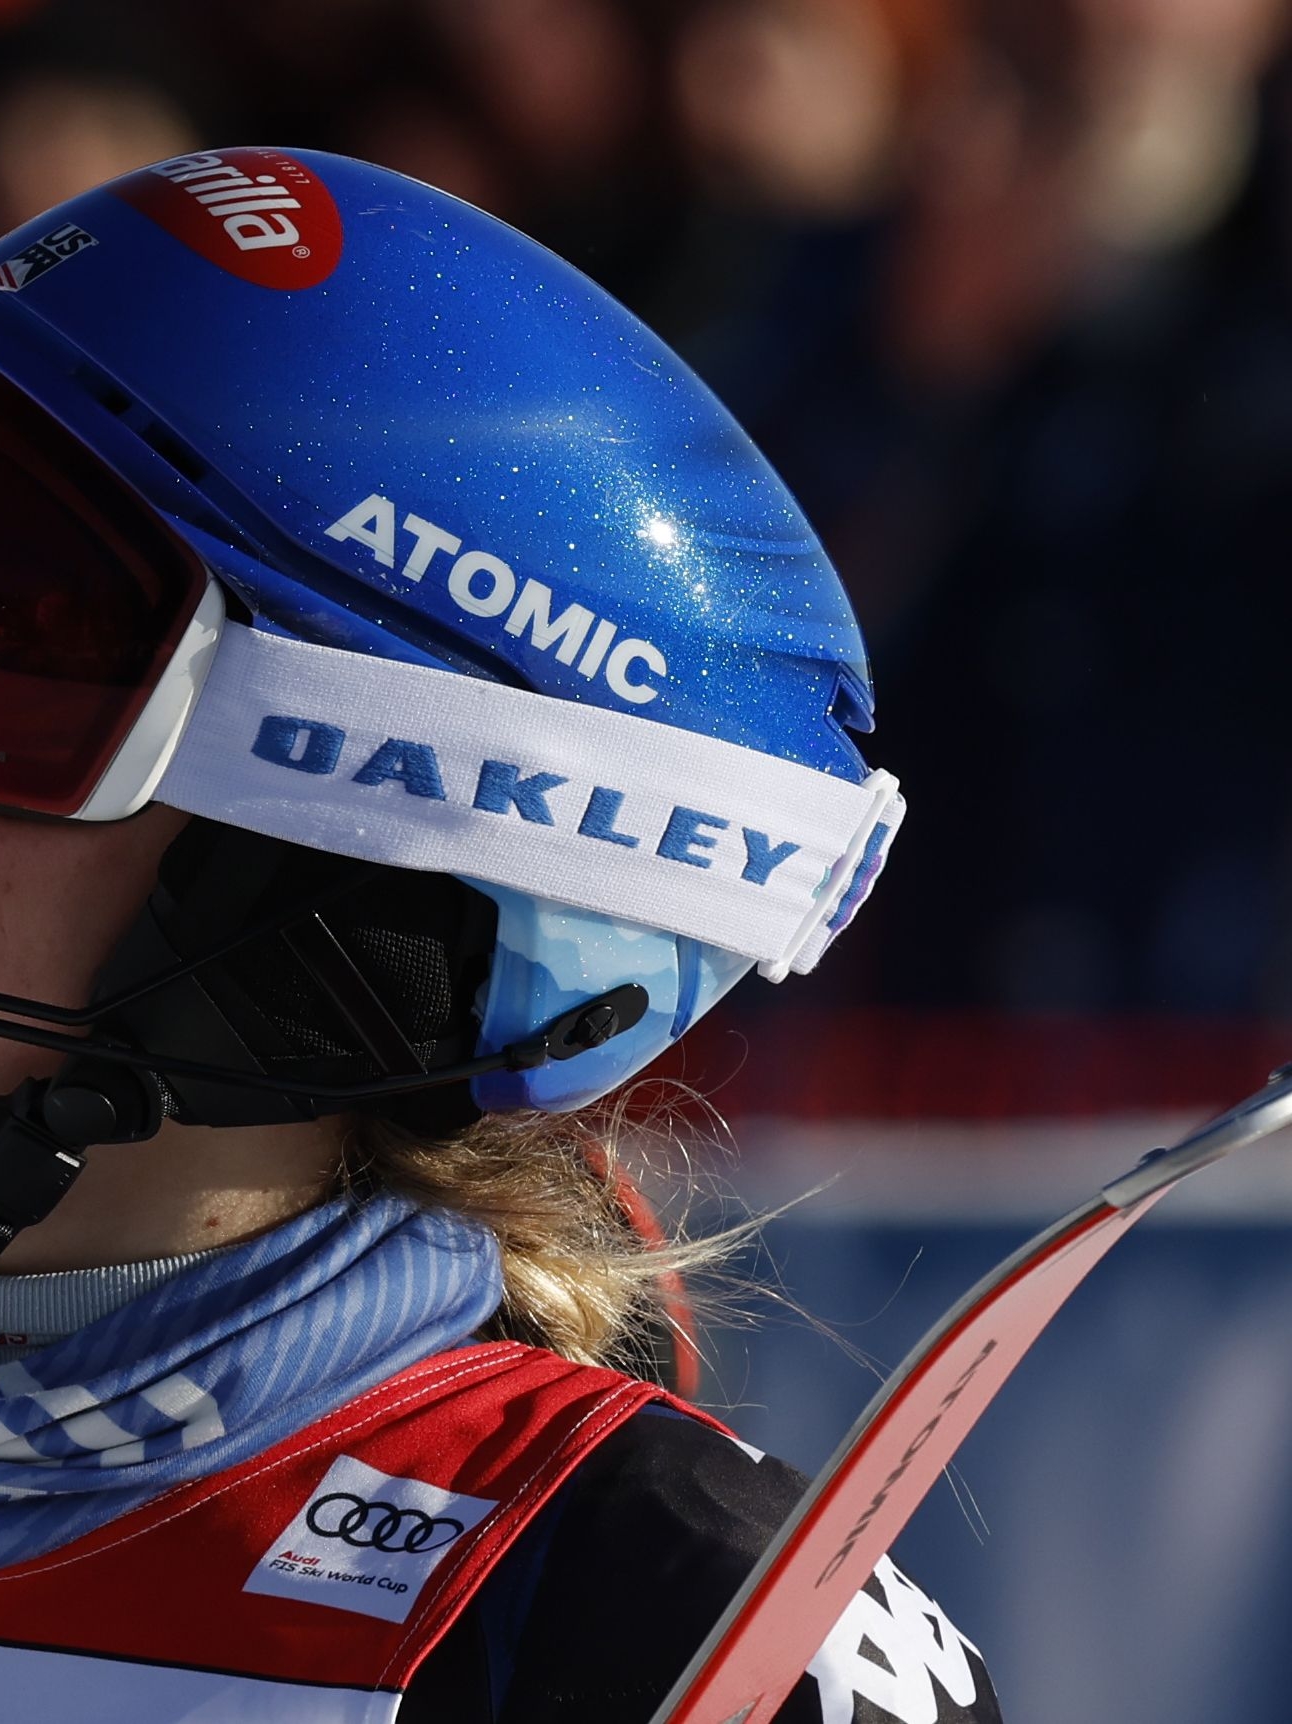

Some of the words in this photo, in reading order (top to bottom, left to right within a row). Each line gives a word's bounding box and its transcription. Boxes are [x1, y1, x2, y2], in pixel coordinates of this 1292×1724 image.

[275, 161, 311, 184] 1877
[324, 493, 667, 704] ATOMIC
[251, 715, 801, 886] OAKLEY
[814, 1338, 998, 1589] ATOMIC
[269, 1559, 296, 1572] FIS
[298, 1566, 325, 1579] Ski
[327, 1571, 375, 1586] World
[377, 1576, 409, 1595] Cup
[278, 1550, 321, 1566] Audi
